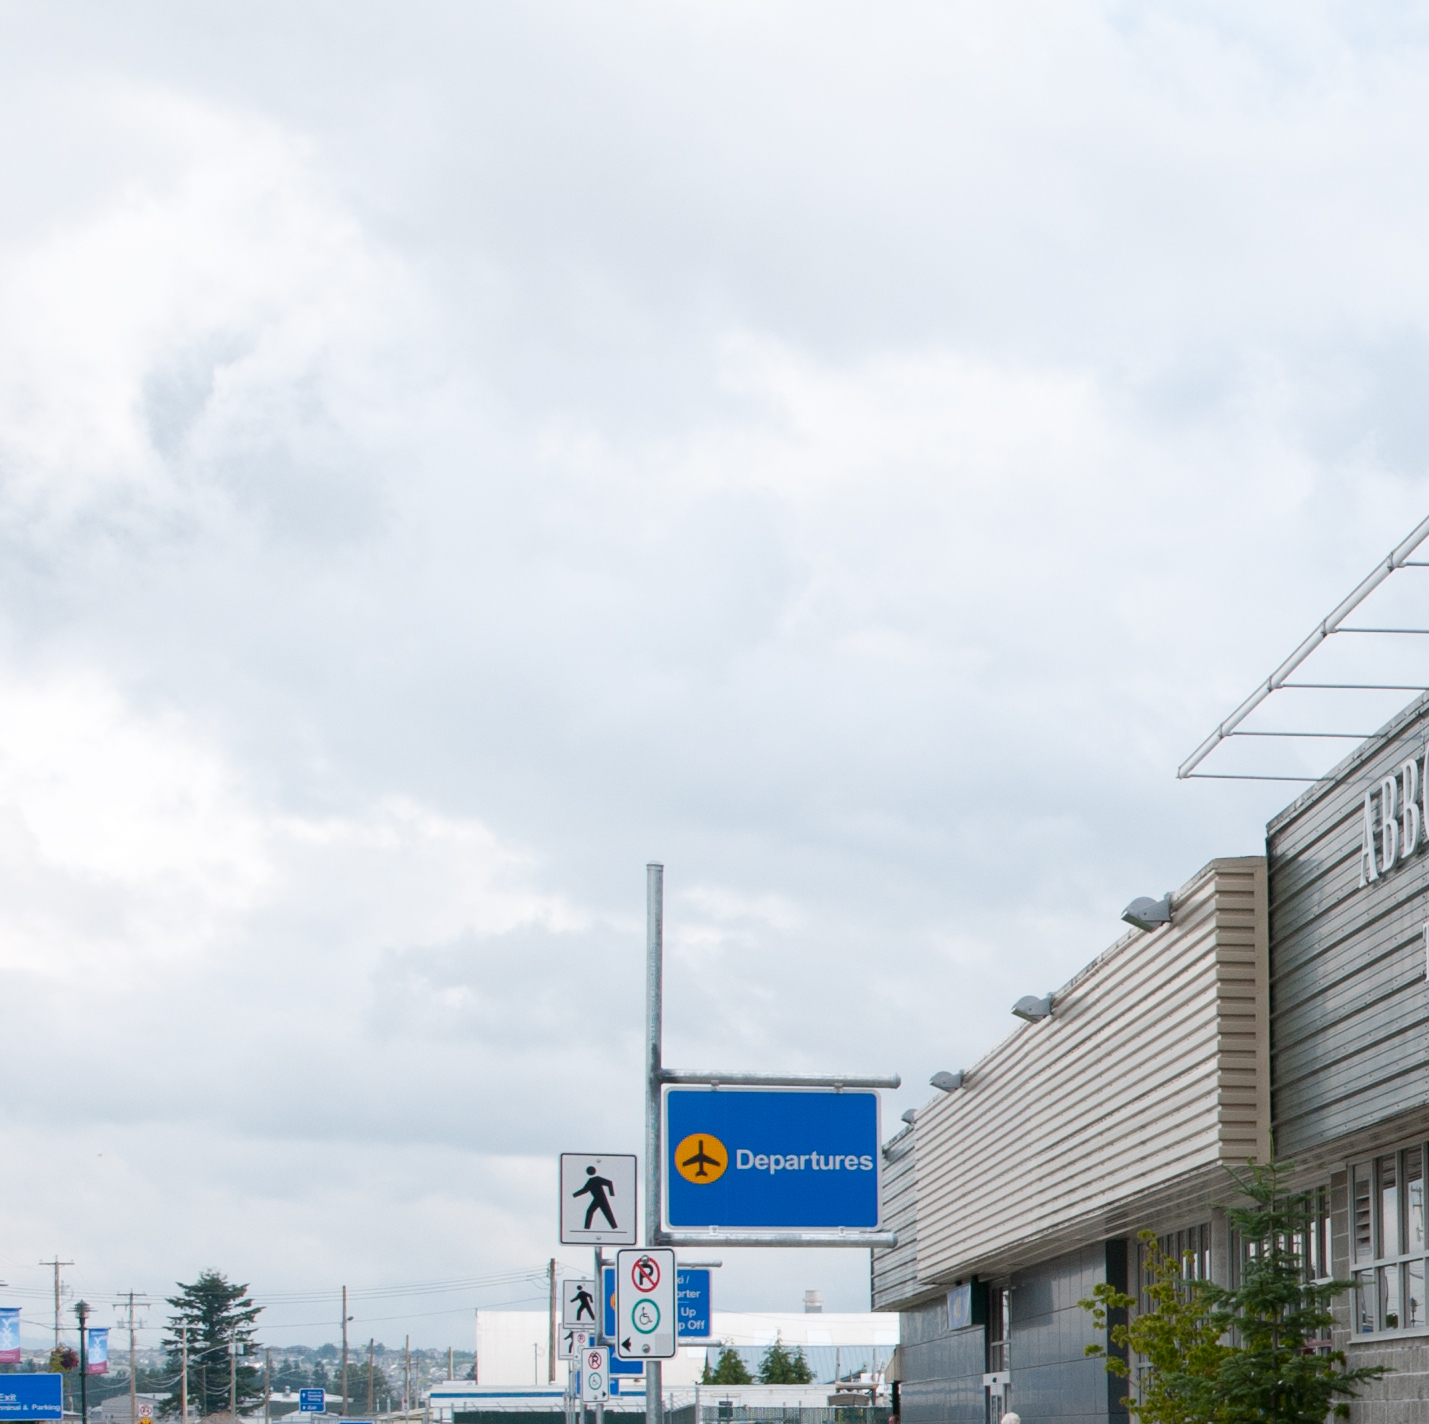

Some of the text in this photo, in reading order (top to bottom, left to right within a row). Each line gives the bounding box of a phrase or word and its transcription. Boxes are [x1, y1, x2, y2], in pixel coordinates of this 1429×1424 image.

[736, 1149, 873, 1175] Departures
[677, 1290, 701, 1298] orter
[681, 1307, 697, 1318] Up
[687, 1320, 705, 1330] Off
[31, 1403, 60, 1412] Parking
